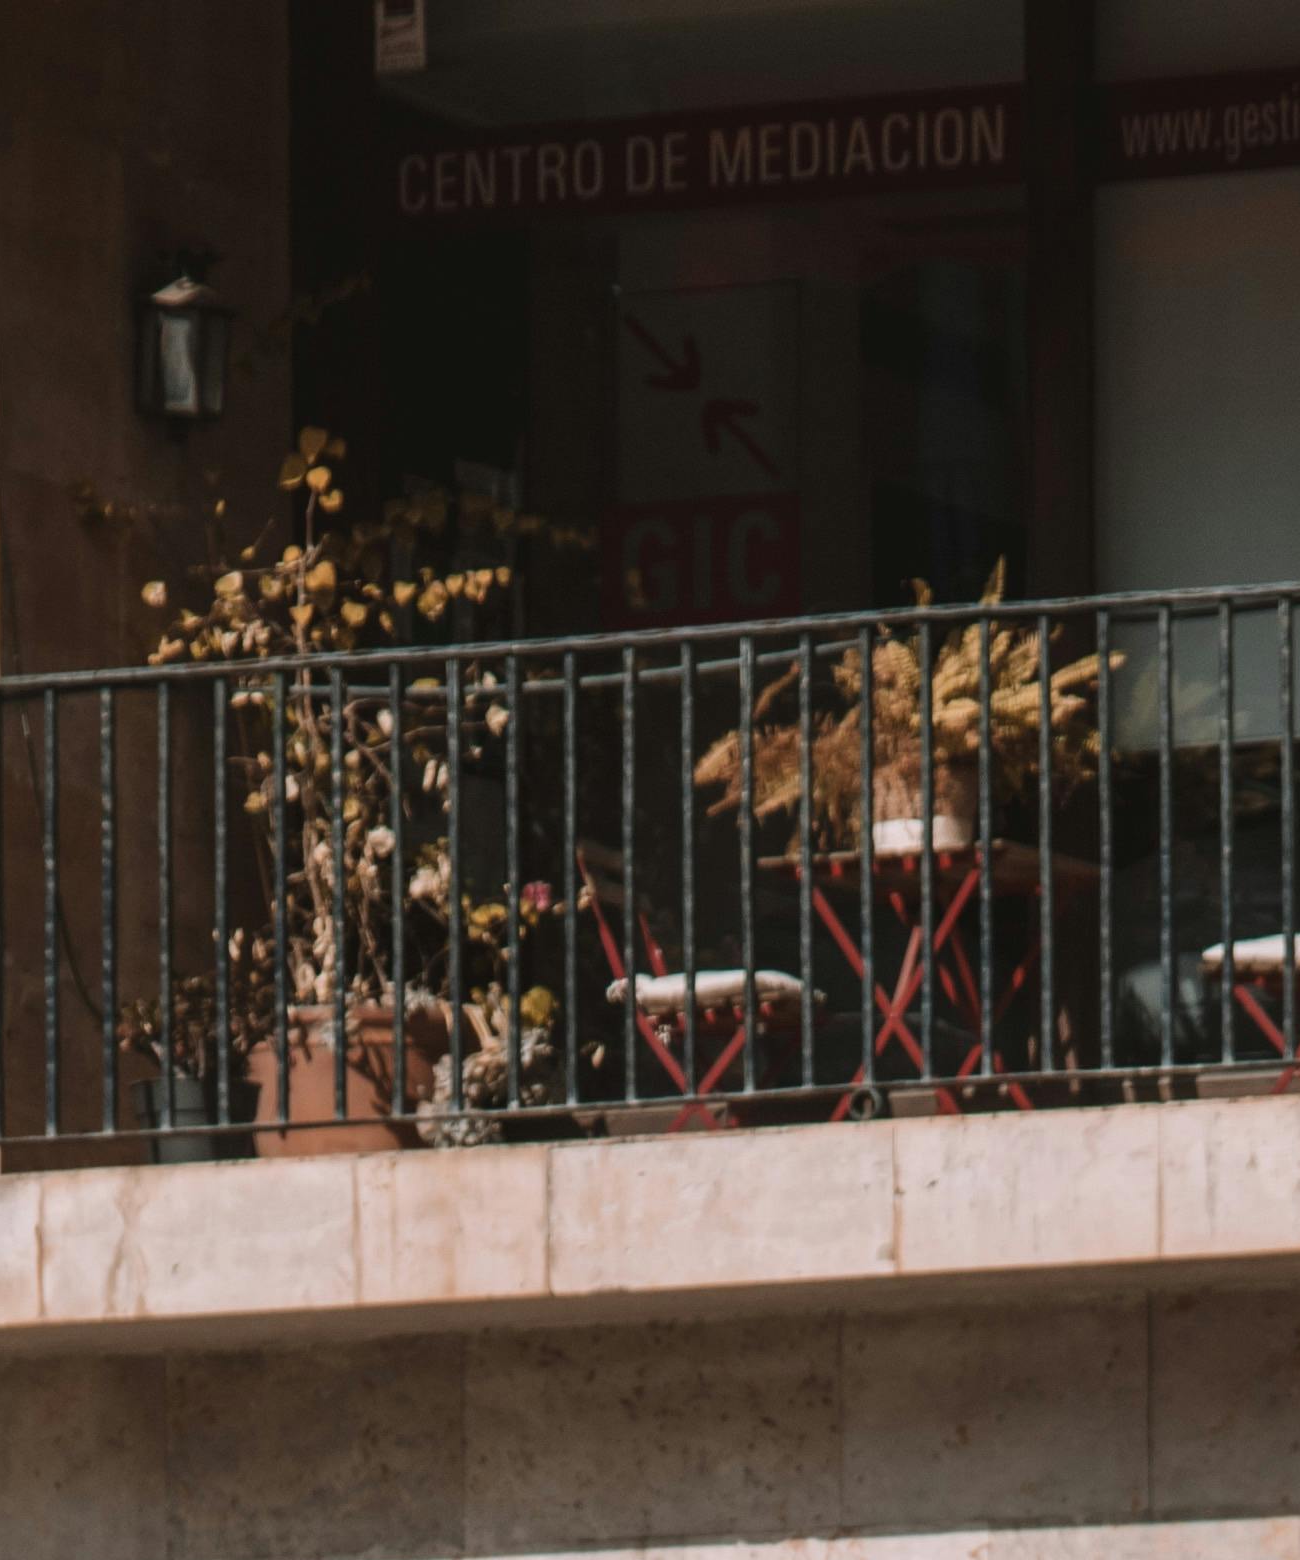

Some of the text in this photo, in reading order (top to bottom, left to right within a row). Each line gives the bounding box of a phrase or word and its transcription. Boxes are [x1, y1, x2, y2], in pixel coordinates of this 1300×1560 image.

[399, 103, 1006, 217] CENTRO DE MEDIACION
[621, 508, 782, 609] GIC
